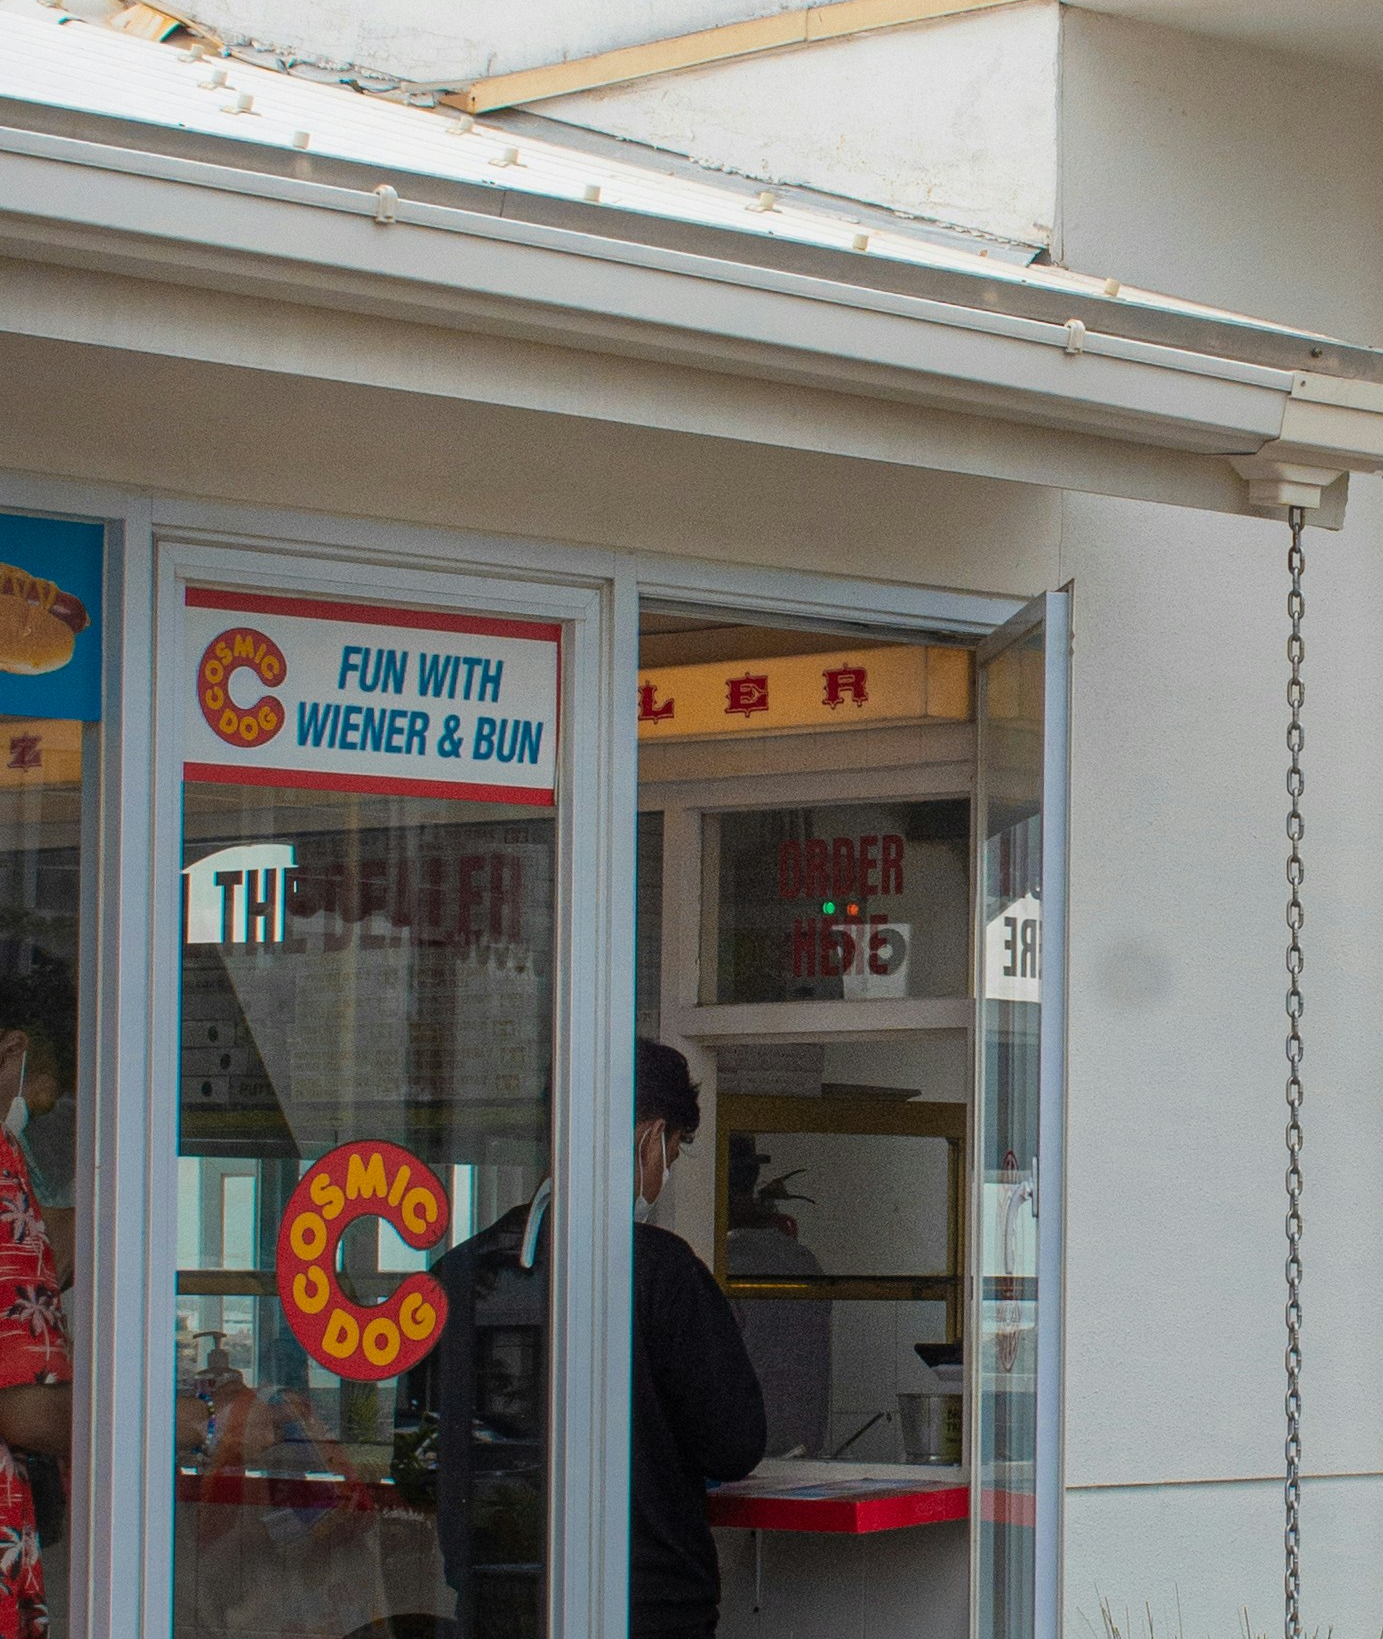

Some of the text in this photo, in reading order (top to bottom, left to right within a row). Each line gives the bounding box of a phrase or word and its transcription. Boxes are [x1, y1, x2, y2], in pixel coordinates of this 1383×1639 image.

[204, 633, 281, 741] COSMIC DOG
[337, 645, 504, 704] FUN WITH
[296, 701, 544, 765] WIENER & BUN
[778, 834, 905, 900] ORDER
[792, 913, 890, 979] HERE
[289, 1151, 439, 1315] COSMIC
[320, 1291, 437, 1367] DOG
